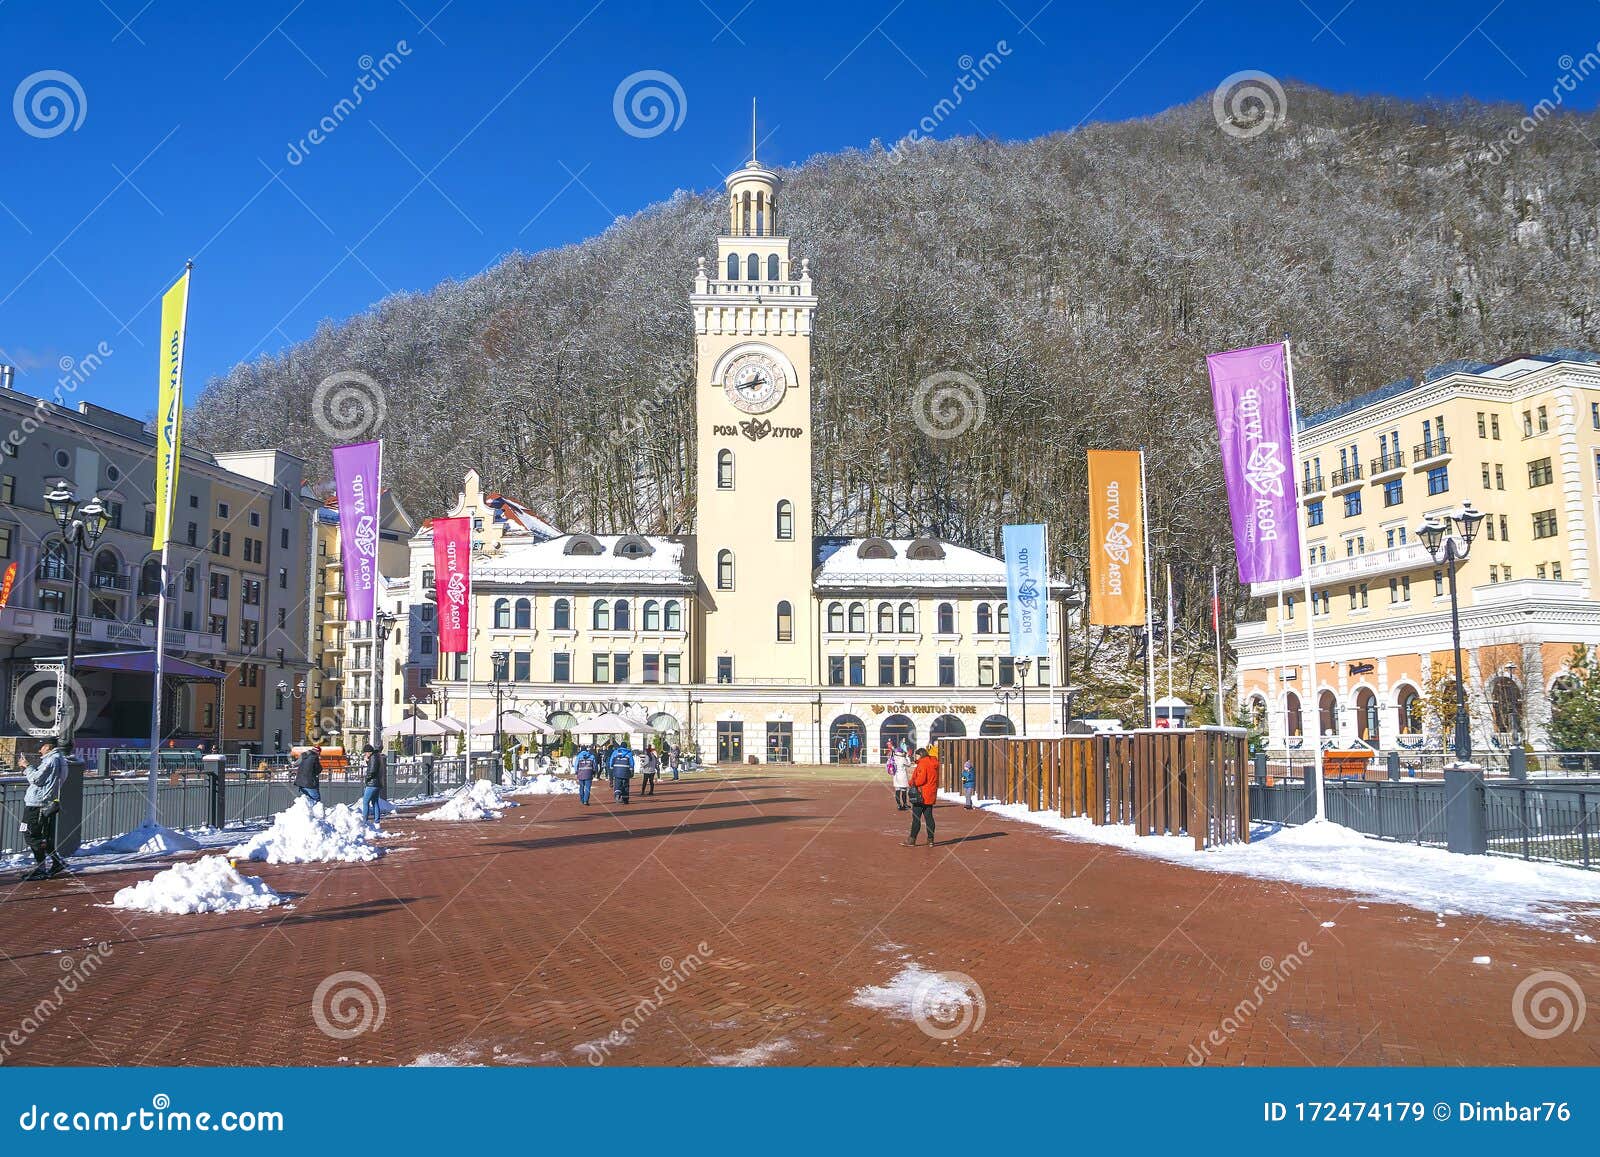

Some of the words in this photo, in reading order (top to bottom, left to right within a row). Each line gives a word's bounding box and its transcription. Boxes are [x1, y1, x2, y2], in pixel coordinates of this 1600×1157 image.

[713, 424, 738, 437] РОЗА
[771, 426, 803, 438] ХУТОР
[551, 700, 623, 713] LUCIANO
[887, 704, 911, 714] ROSA
[912, 704, 947, 714] KHUTOR
[949, 705, 977, 715] STORE
